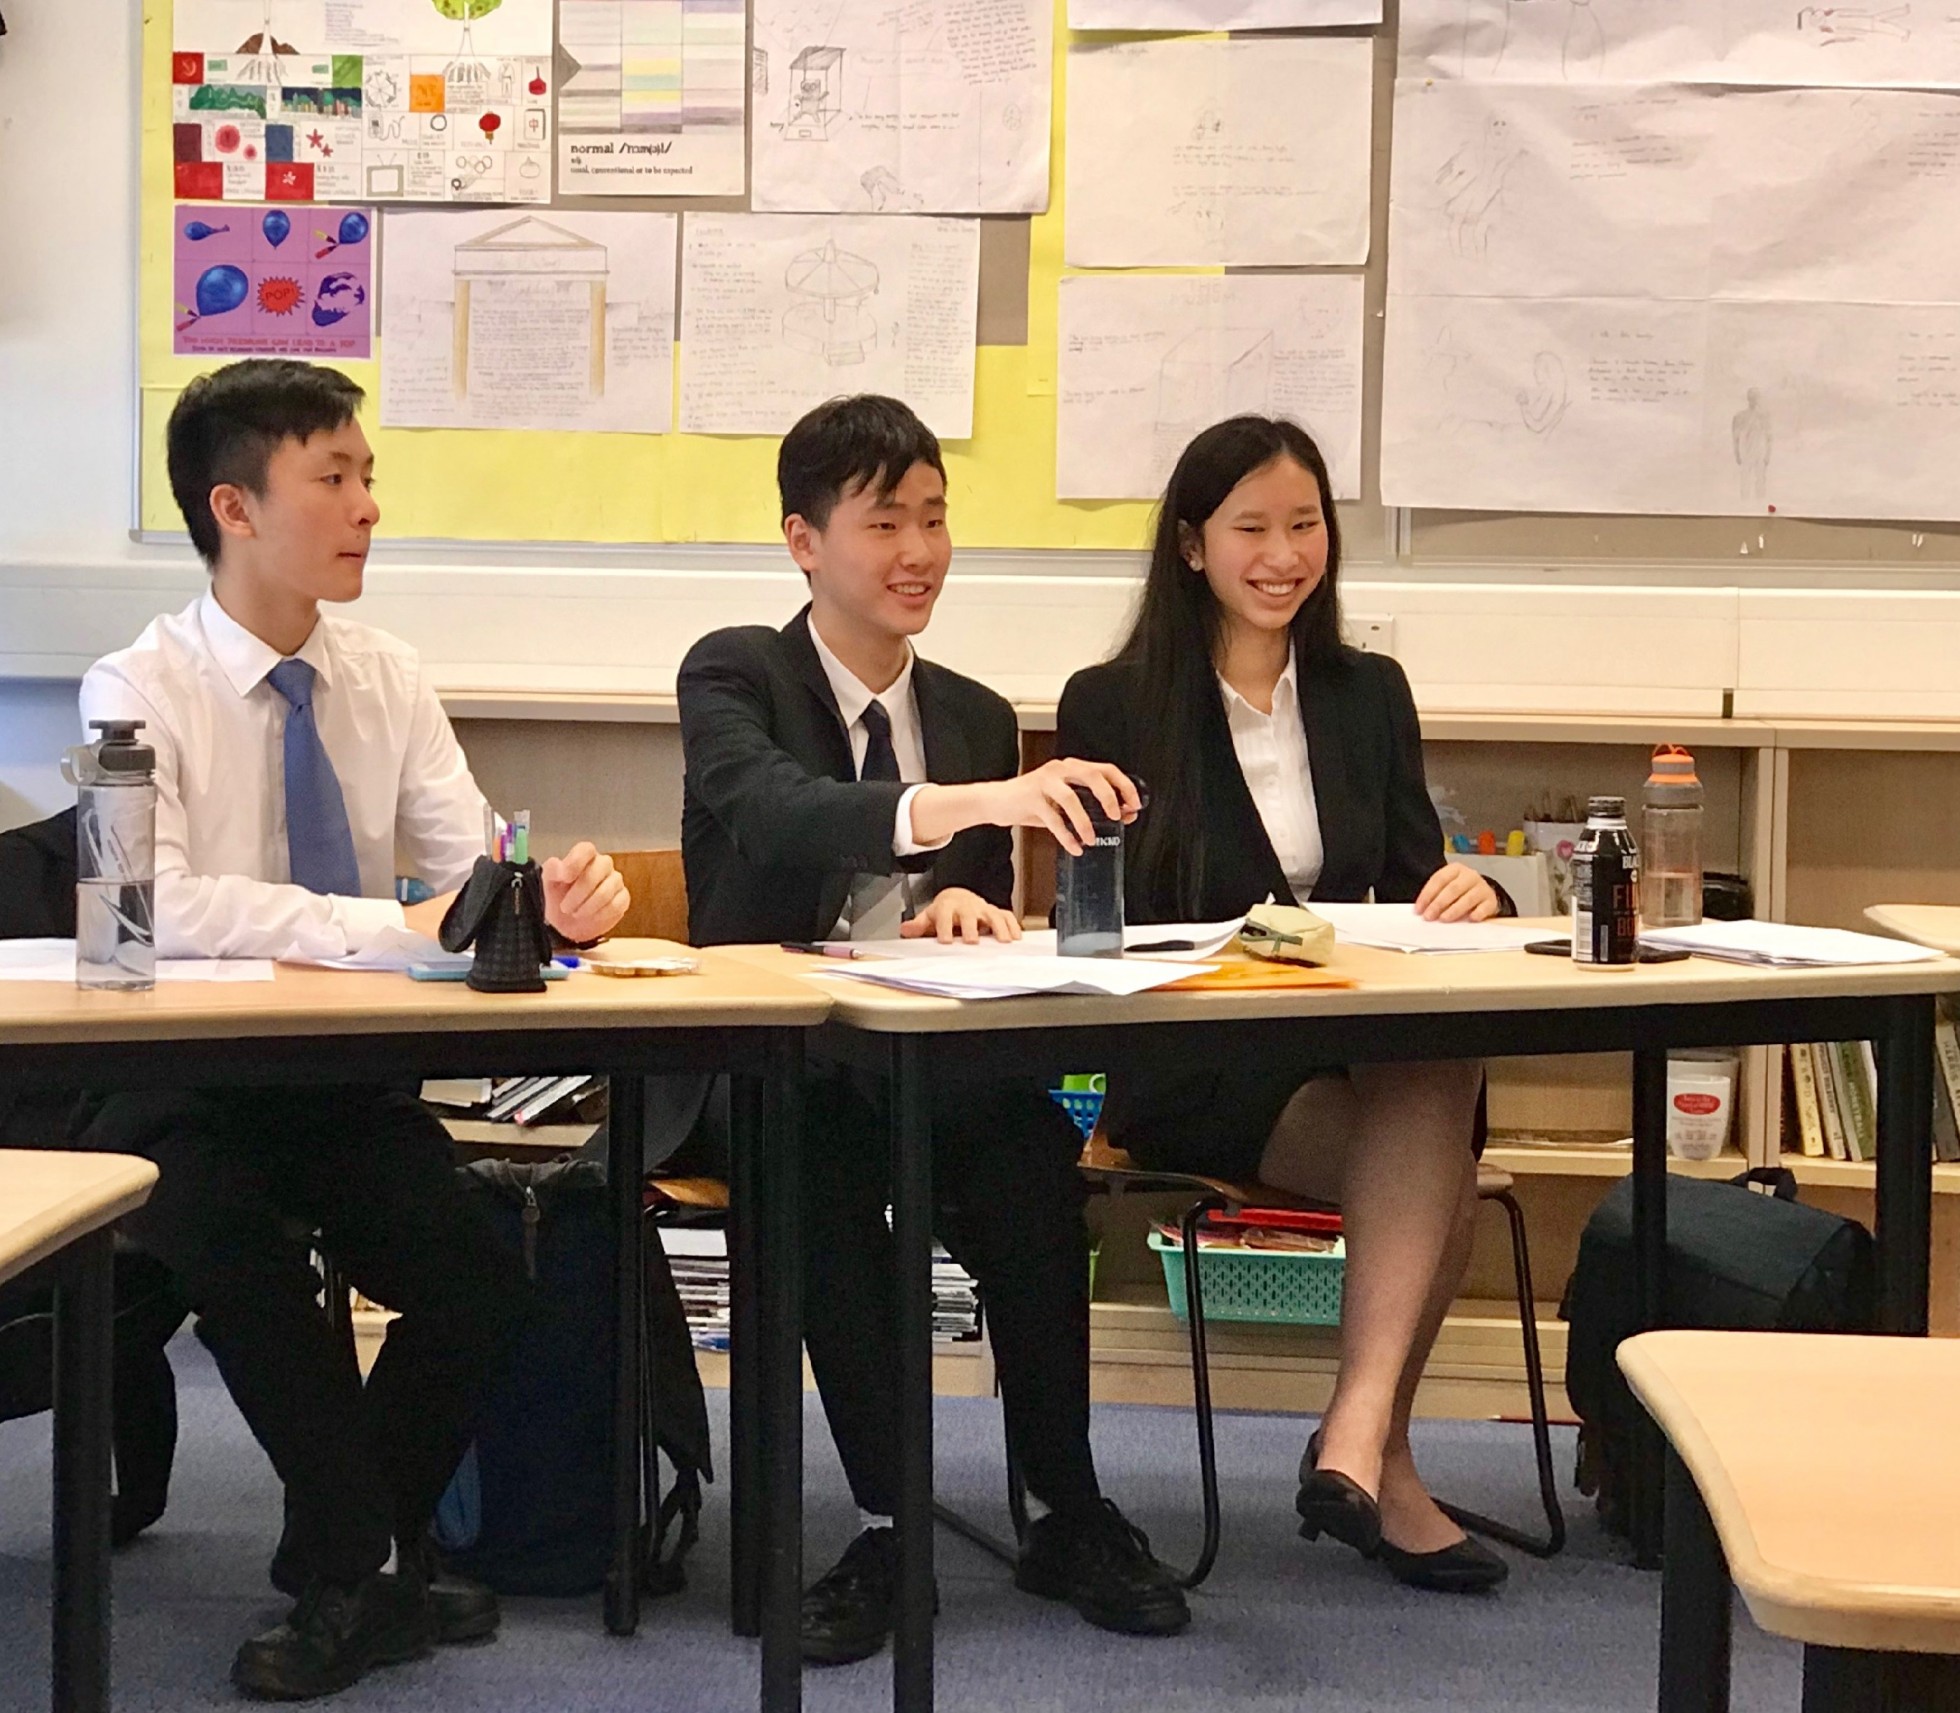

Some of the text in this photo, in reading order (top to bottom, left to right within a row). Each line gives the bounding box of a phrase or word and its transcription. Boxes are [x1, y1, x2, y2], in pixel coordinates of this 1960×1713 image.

[570, 142, 614, 154] normal
[645, 166, 652, 174] to
[653, 166, 662, 174] be
[663, 166, 693, 176] expected
